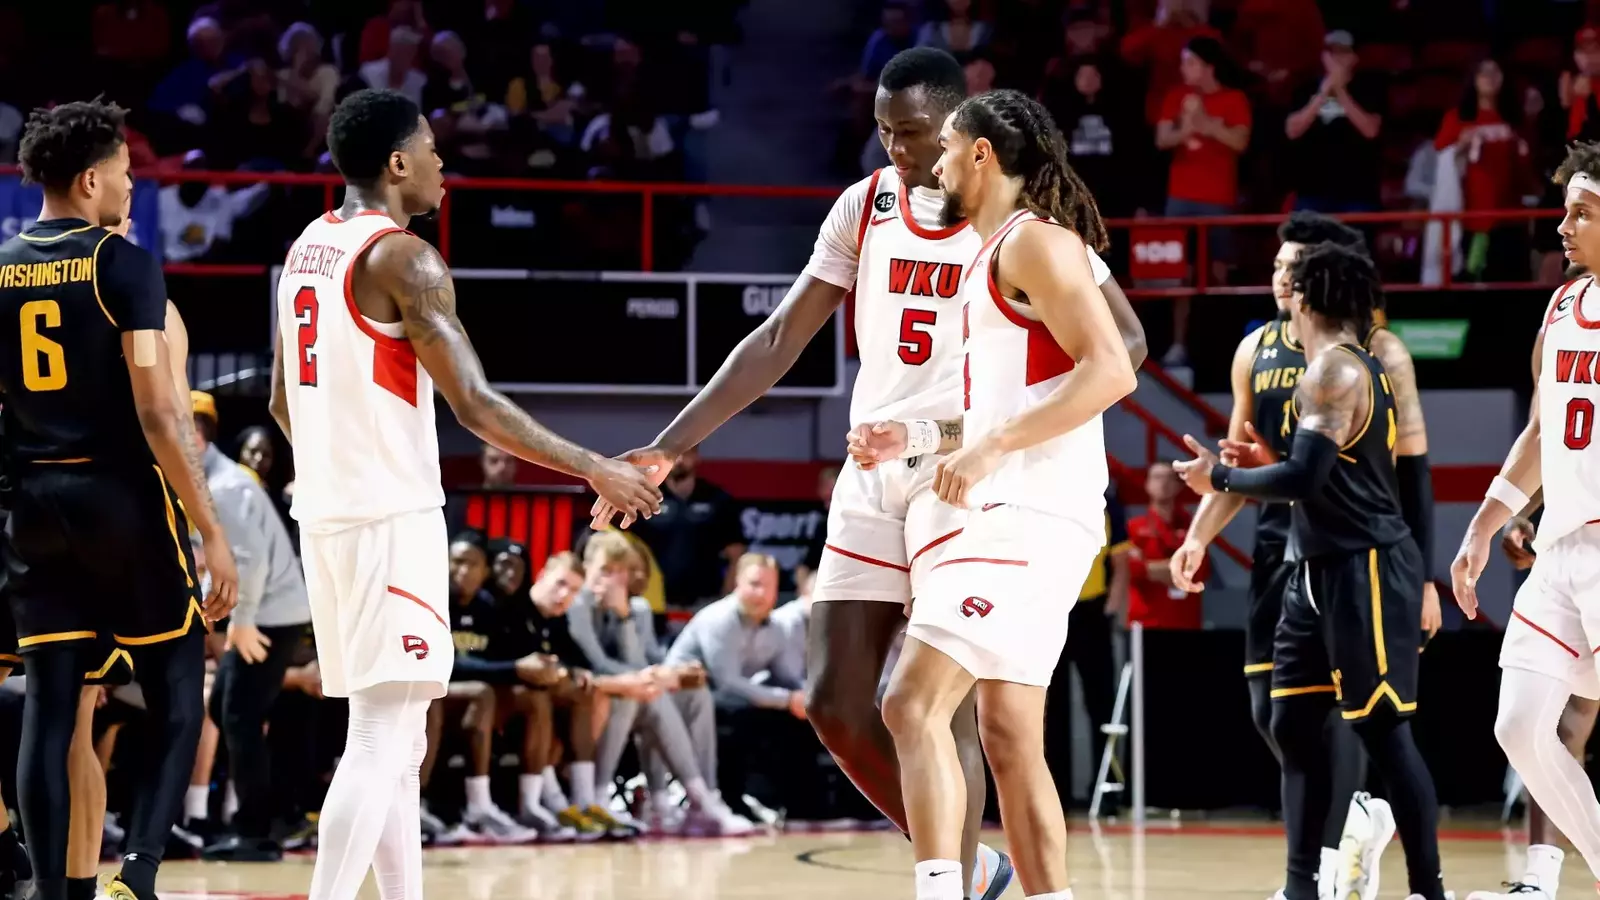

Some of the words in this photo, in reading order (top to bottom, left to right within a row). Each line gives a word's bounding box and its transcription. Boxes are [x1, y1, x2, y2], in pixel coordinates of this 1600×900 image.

[877, 194, 894, 209] 45
[286, 244, 346, 279] McHENRY
[889, 257, 963, 298] WKU
[742, 285, 791, 316] GU
[20, 300, 67, 392] 6
[294, 286, 319, 388] 2
[897, 308, 937, 366] 5
[1556, 349, 1600, 385] WK
[1564, 398, 1595, 450] 0
